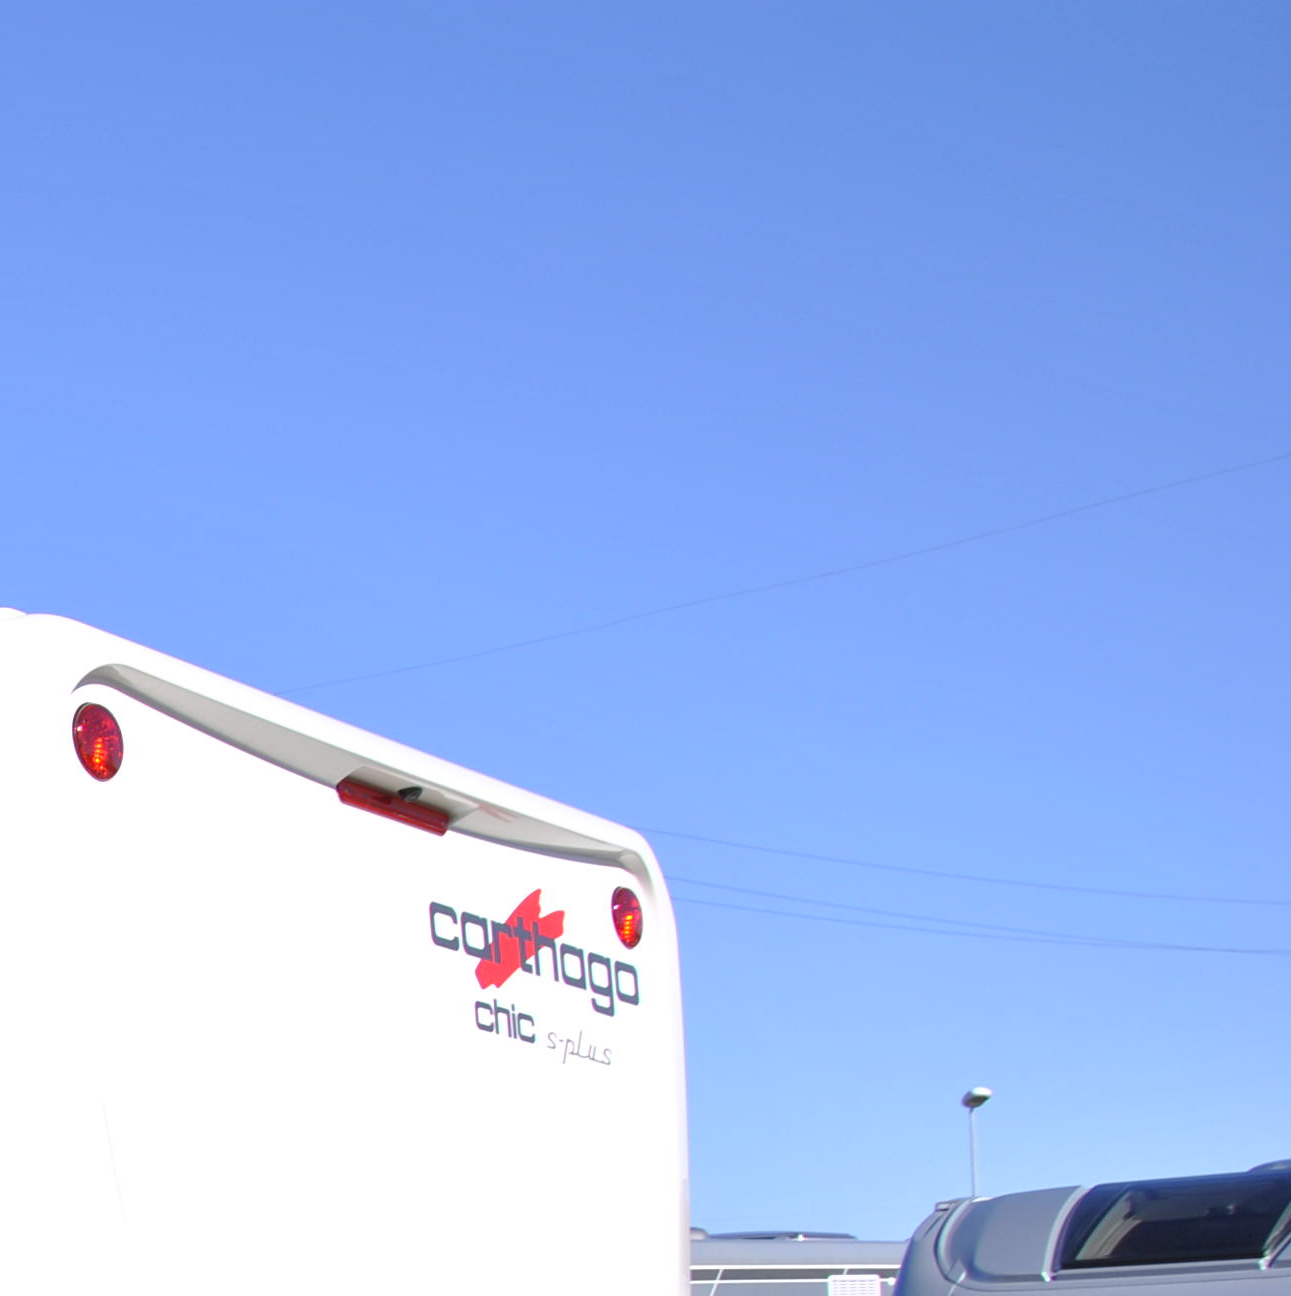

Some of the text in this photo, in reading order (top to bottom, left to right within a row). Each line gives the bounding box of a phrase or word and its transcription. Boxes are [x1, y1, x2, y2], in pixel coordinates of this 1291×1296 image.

[429, 901, 640, 1017] carthago
[474, 998, 612, 1066] chic s-plus
